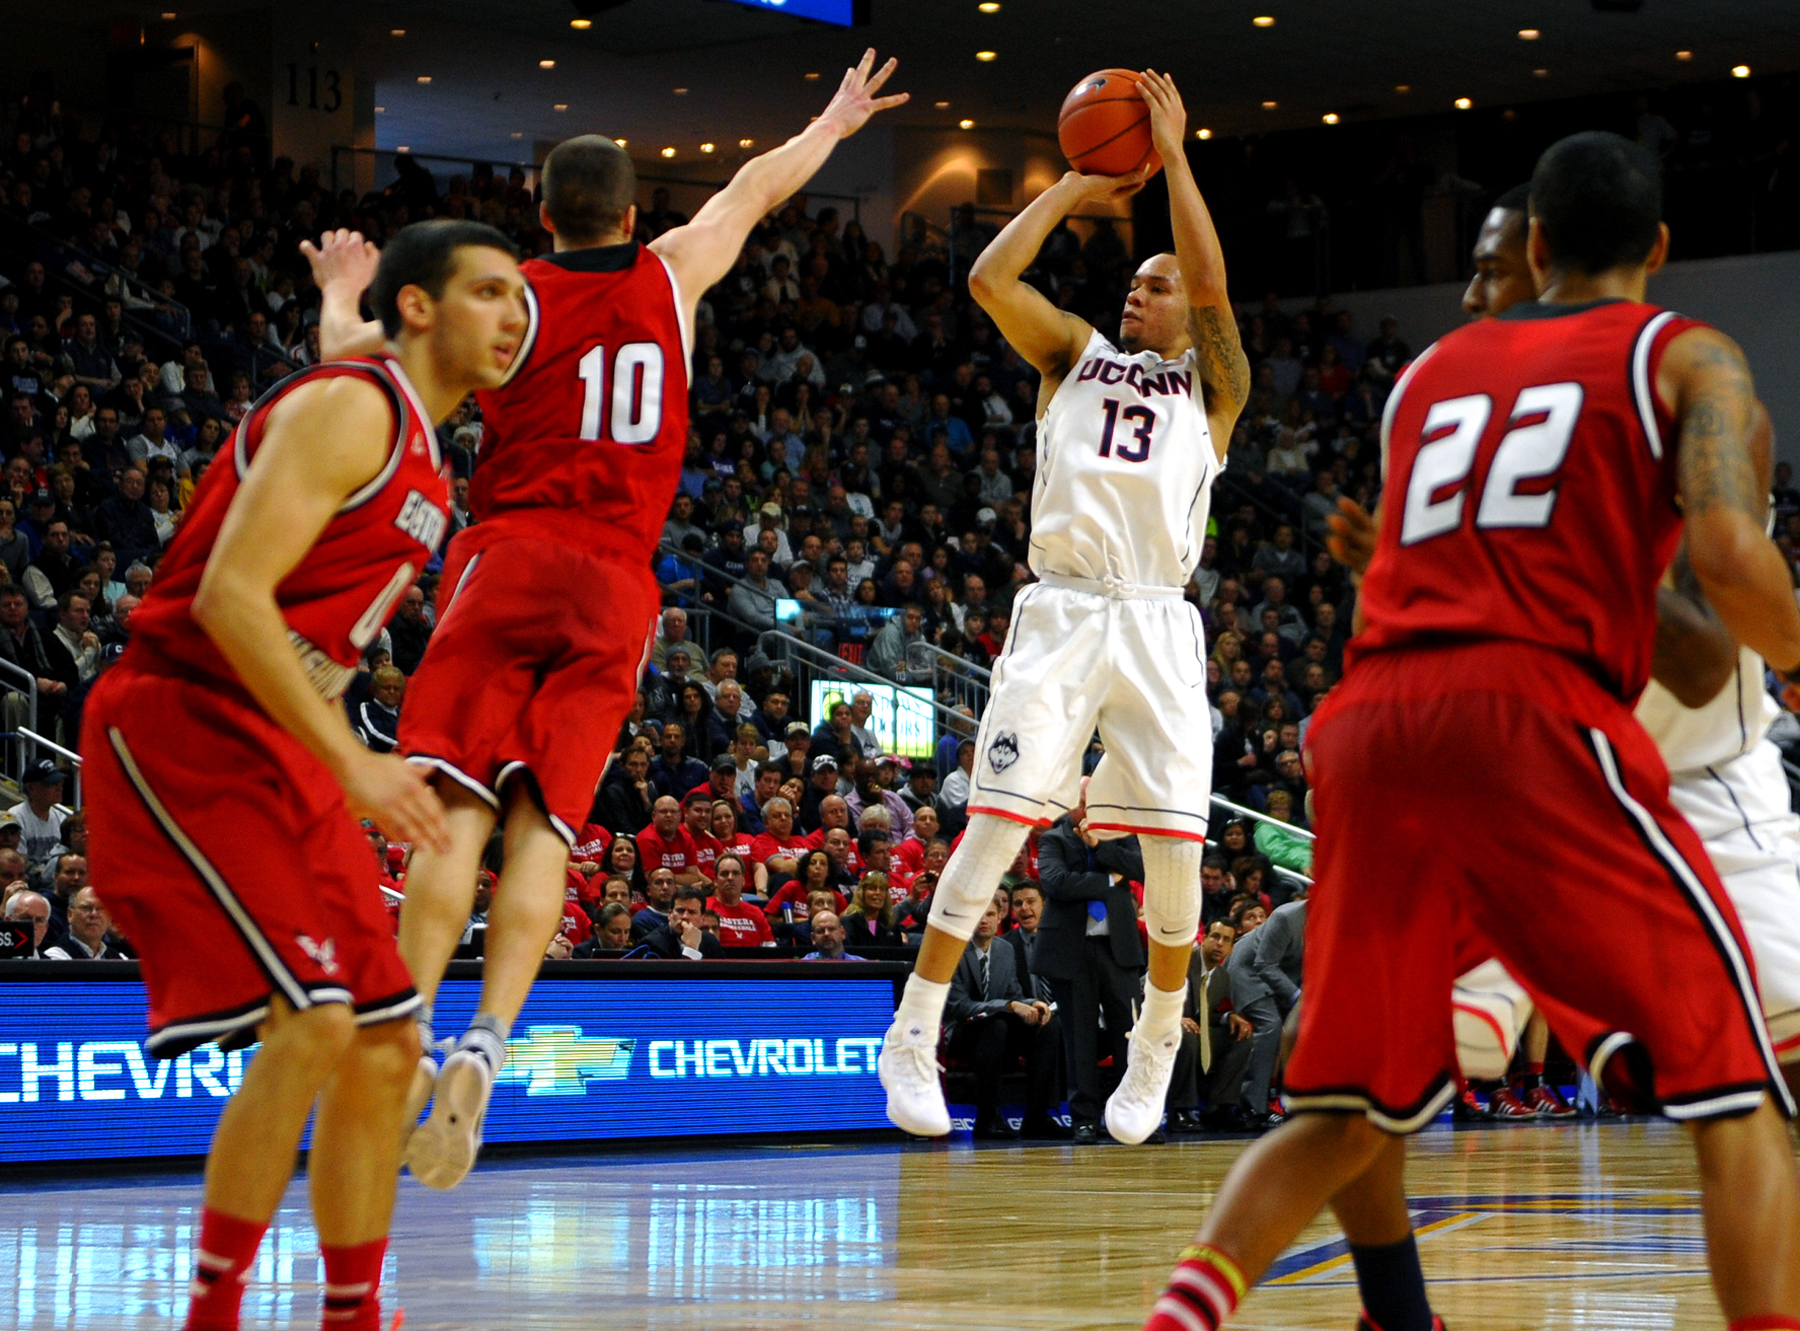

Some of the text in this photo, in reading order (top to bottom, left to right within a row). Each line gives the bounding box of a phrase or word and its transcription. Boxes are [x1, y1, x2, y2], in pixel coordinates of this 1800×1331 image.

[286, 62, 342, 113] 113
[578, 342, 664, 444] 10
[1077, 358, 1193, 400] UCONN
[1098, 398, 1157, 462] 13
[1400, 381, 1584, 546] 22
[840, 643, 863, 665] EXIT
[895, 670, 906, 681] 113
[649, 1038, 883, 1078] CHEVROLET
